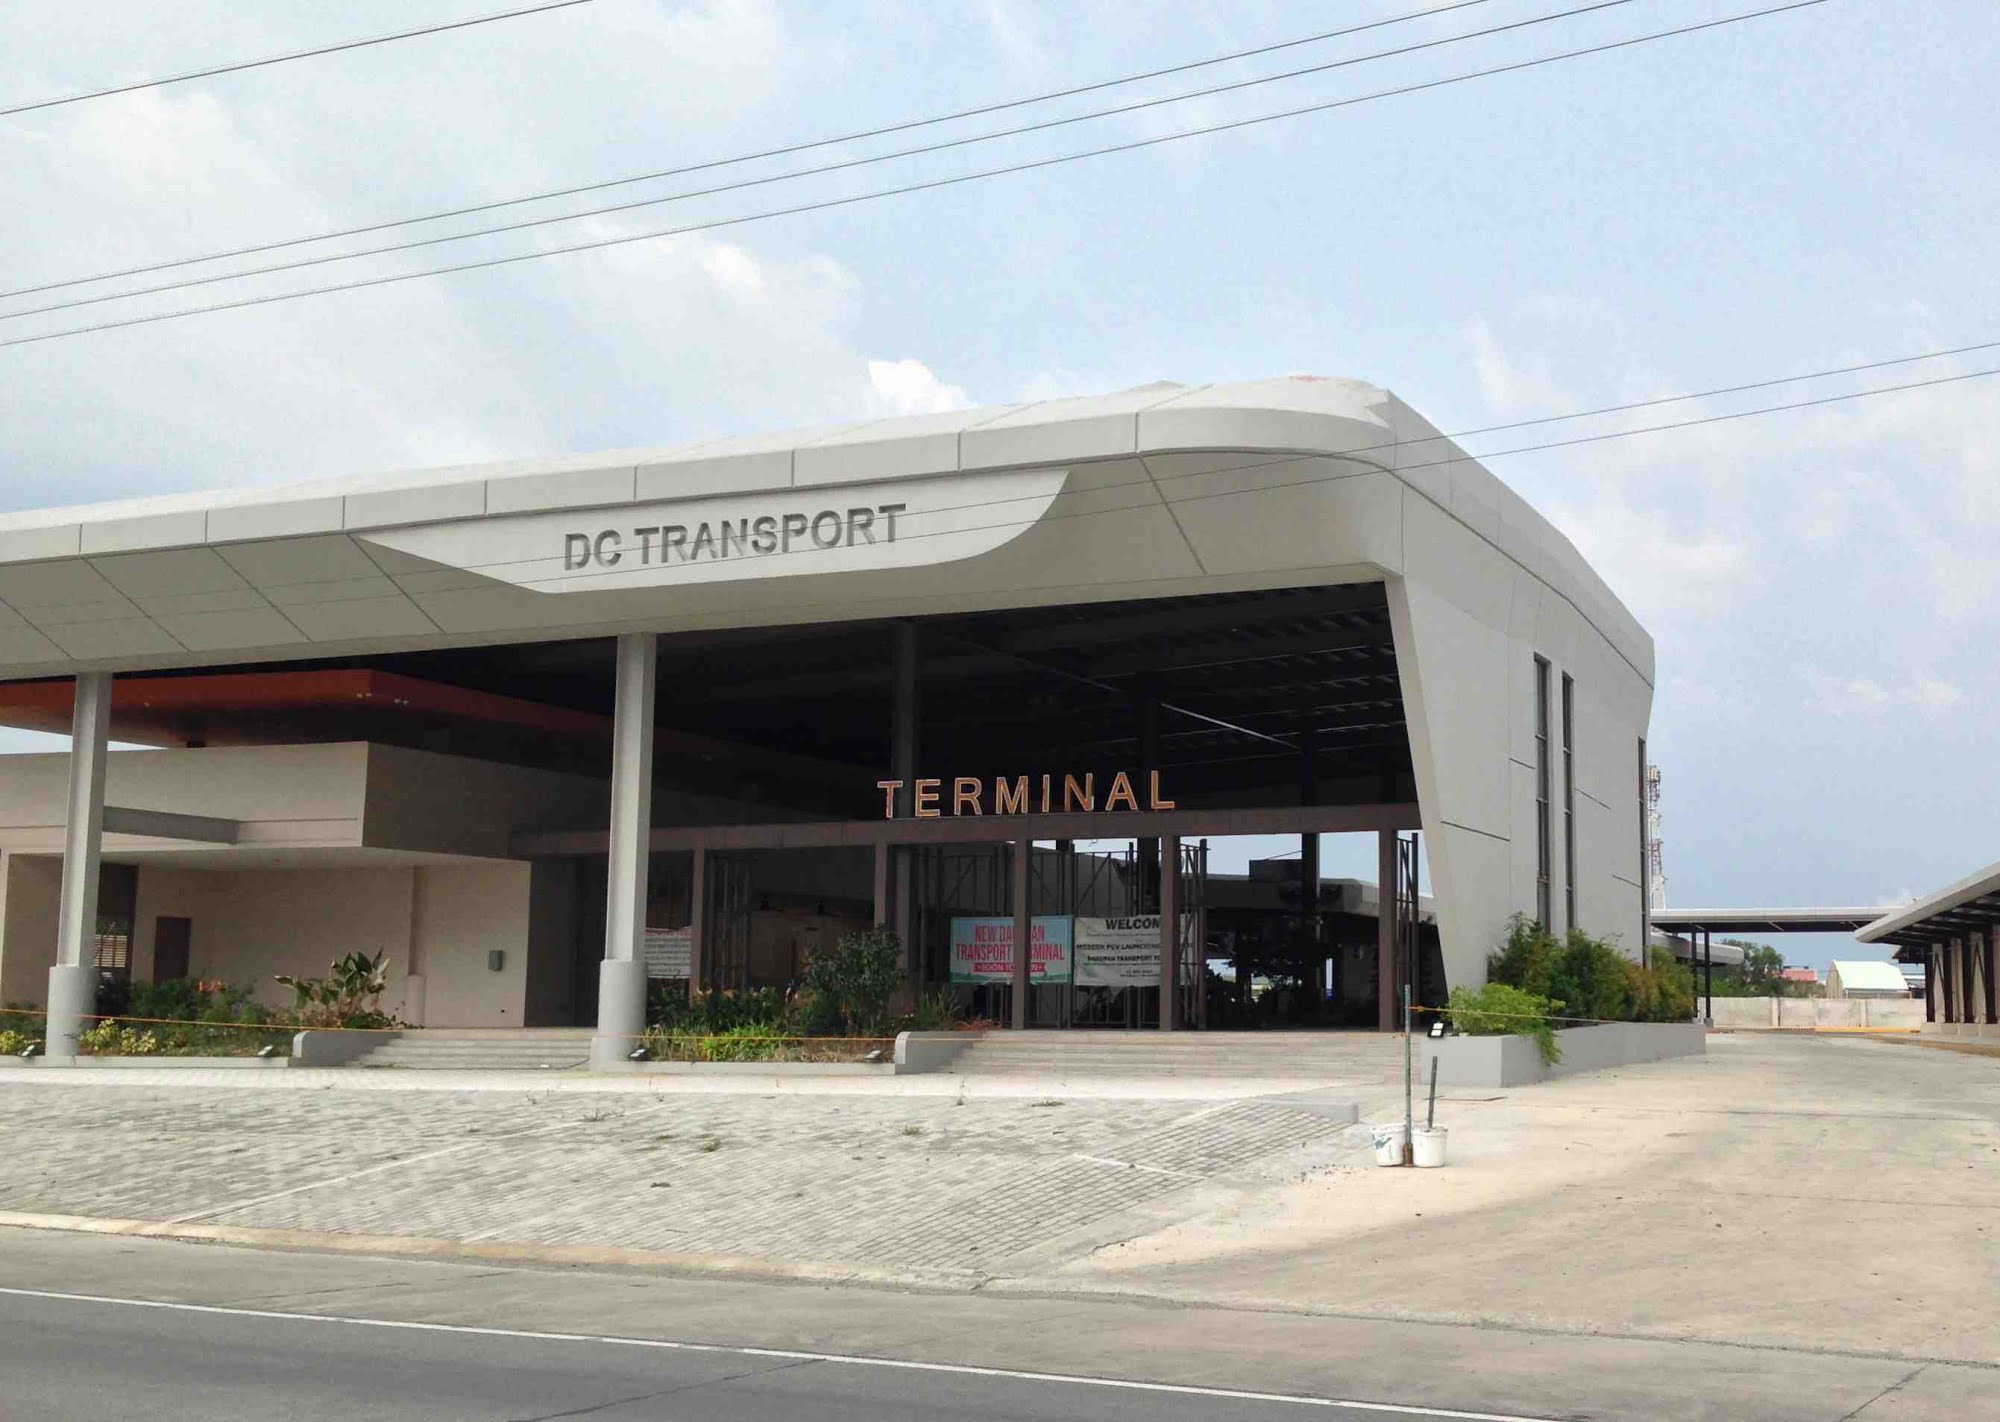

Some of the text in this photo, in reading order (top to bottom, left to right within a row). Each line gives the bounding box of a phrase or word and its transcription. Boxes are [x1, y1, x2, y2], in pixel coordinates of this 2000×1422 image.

[564, 503, 906, 571] DC TRANSPORT
[877, 770, 1175, 818] TERMINAL
[974, 925, 998, 942] NEW
[956, 943, 1012, 961] TRANSPORT
